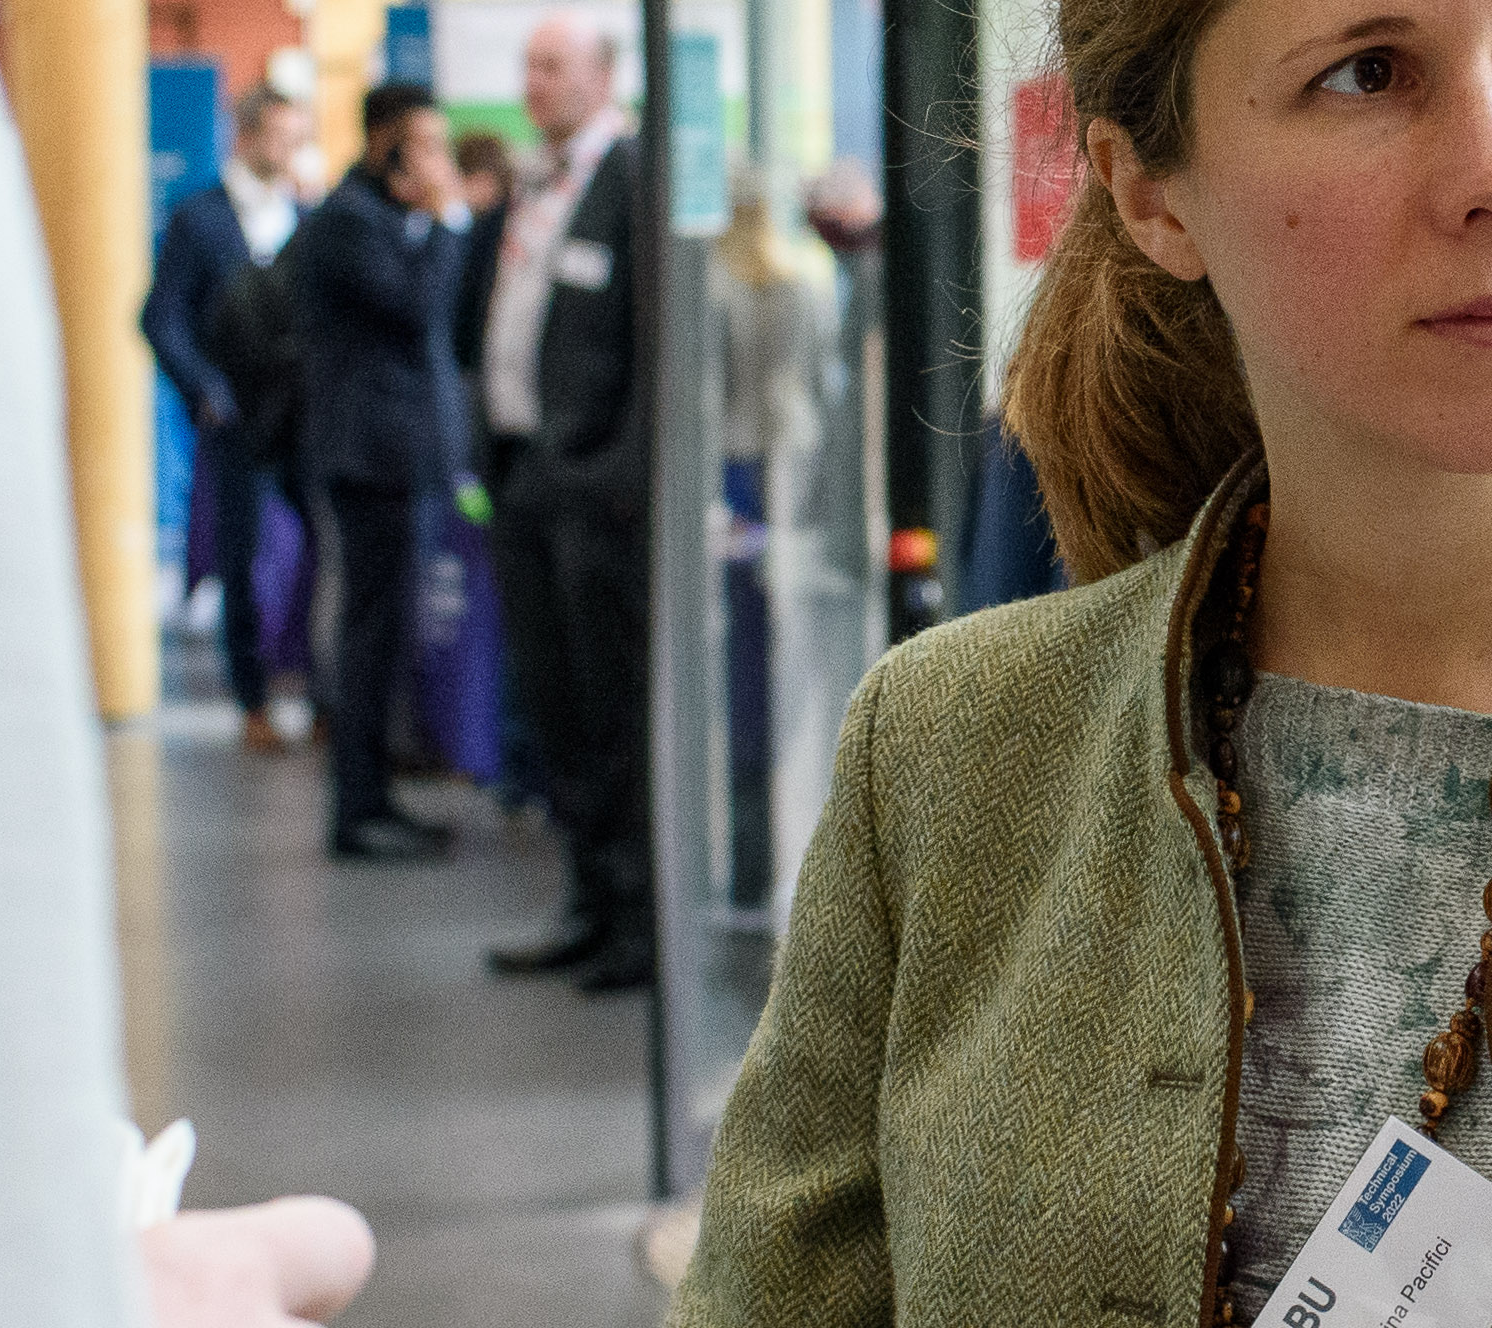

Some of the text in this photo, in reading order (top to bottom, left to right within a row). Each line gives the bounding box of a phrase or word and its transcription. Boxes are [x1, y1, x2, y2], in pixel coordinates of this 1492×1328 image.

[1358, 1152, 1398, 1207] Technical
[1369, 1148, 1418, 1215] Symposium
[1382, 1193, 1406, 1224] 2022
[1400, 1236, 1454, 1304] Pacifici
